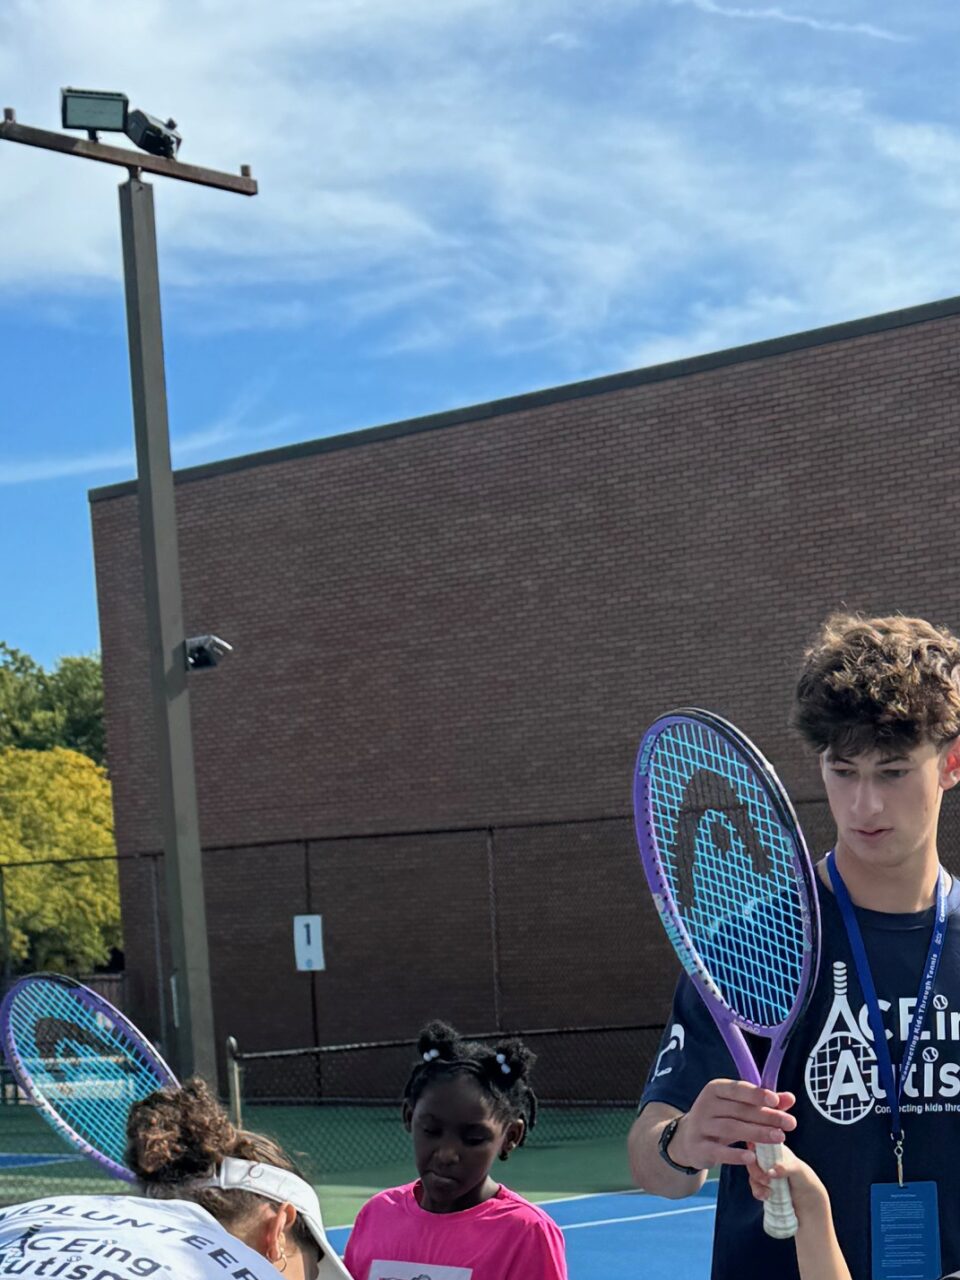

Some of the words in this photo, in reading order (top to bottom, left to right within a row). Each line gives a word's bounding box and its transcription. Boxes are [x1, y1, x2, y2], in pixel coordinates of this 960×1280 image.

[303, 923, 312, 946] 1
[926, 953, 938, 980] Tennis
[918, 980, 932, 1014] Through
[913, 1015, 924, 1034] Kids
[925, 1103, 943, 1113] kids
